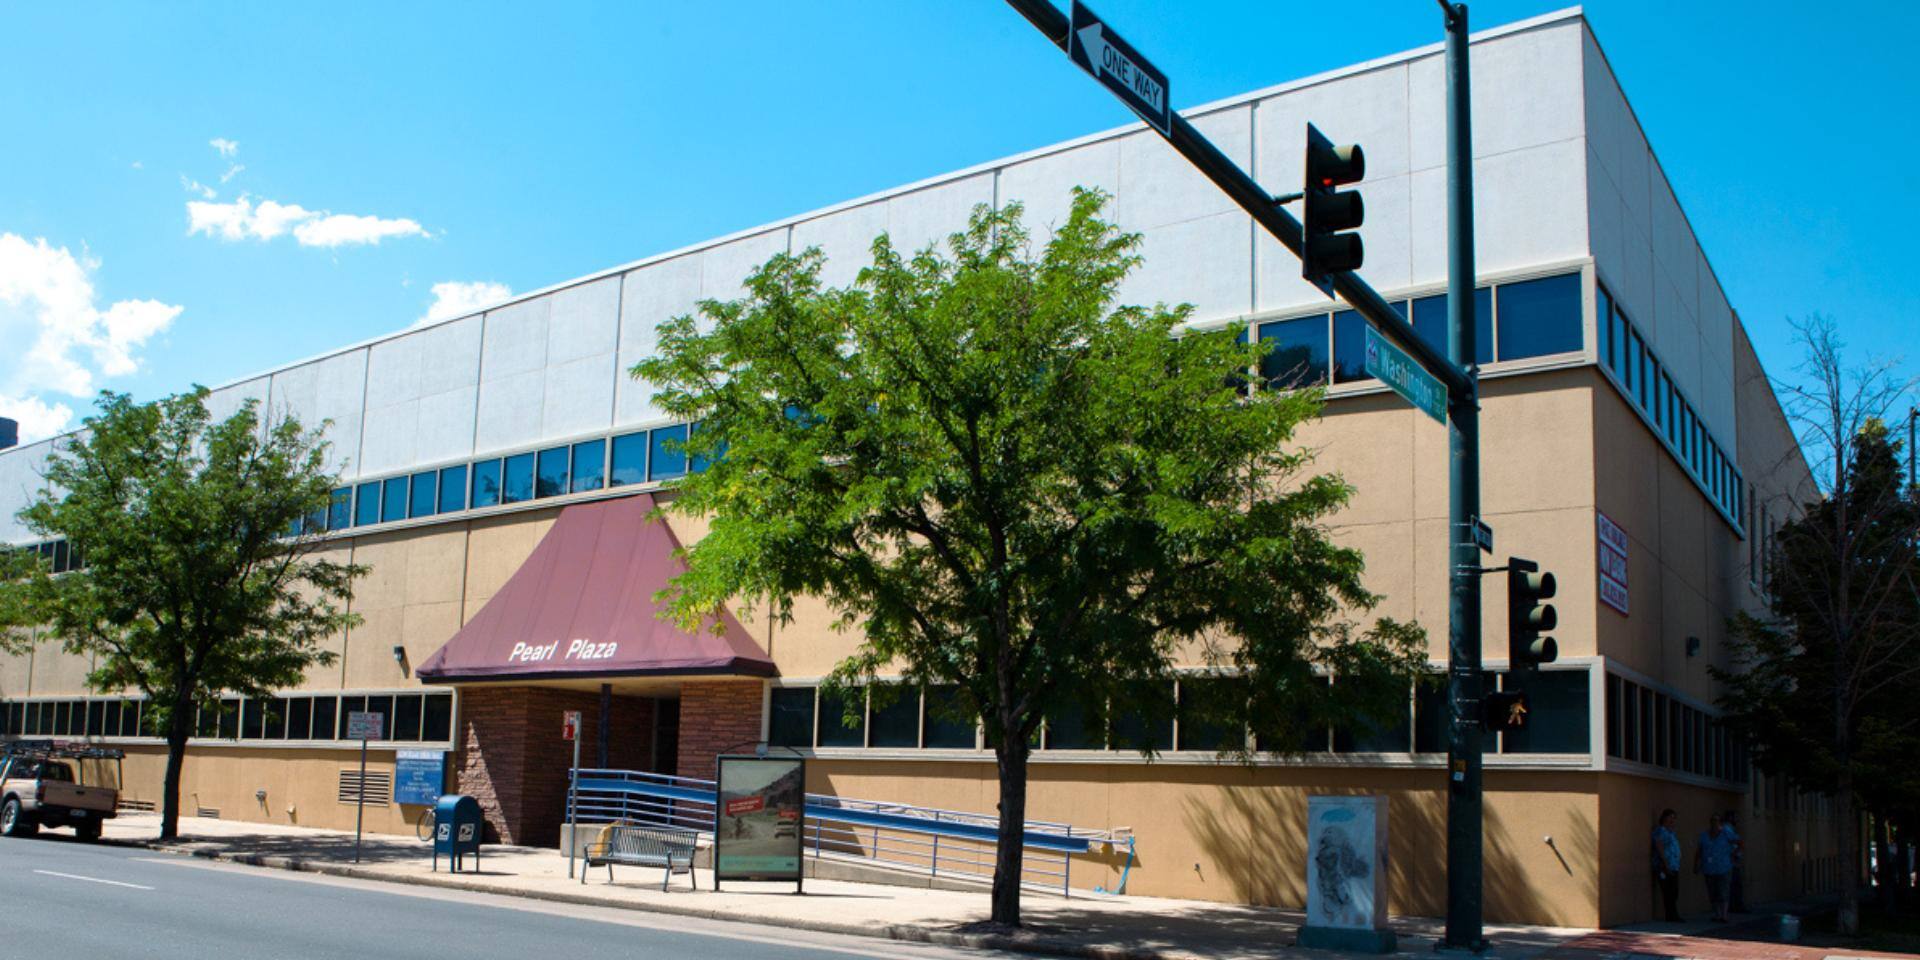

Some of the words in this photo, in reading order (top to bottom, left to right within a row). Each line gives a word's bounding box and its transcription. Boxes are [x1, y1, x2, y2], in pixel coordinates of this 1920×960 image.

[1103, 45, 1129, 83] ONE
[1133, 67, 1160, 106] WAY
[1381, 345, 1432, 409] Washington
[508, 640, 559, 661] Pearl
[565, 639, 617, 659] Plaza
